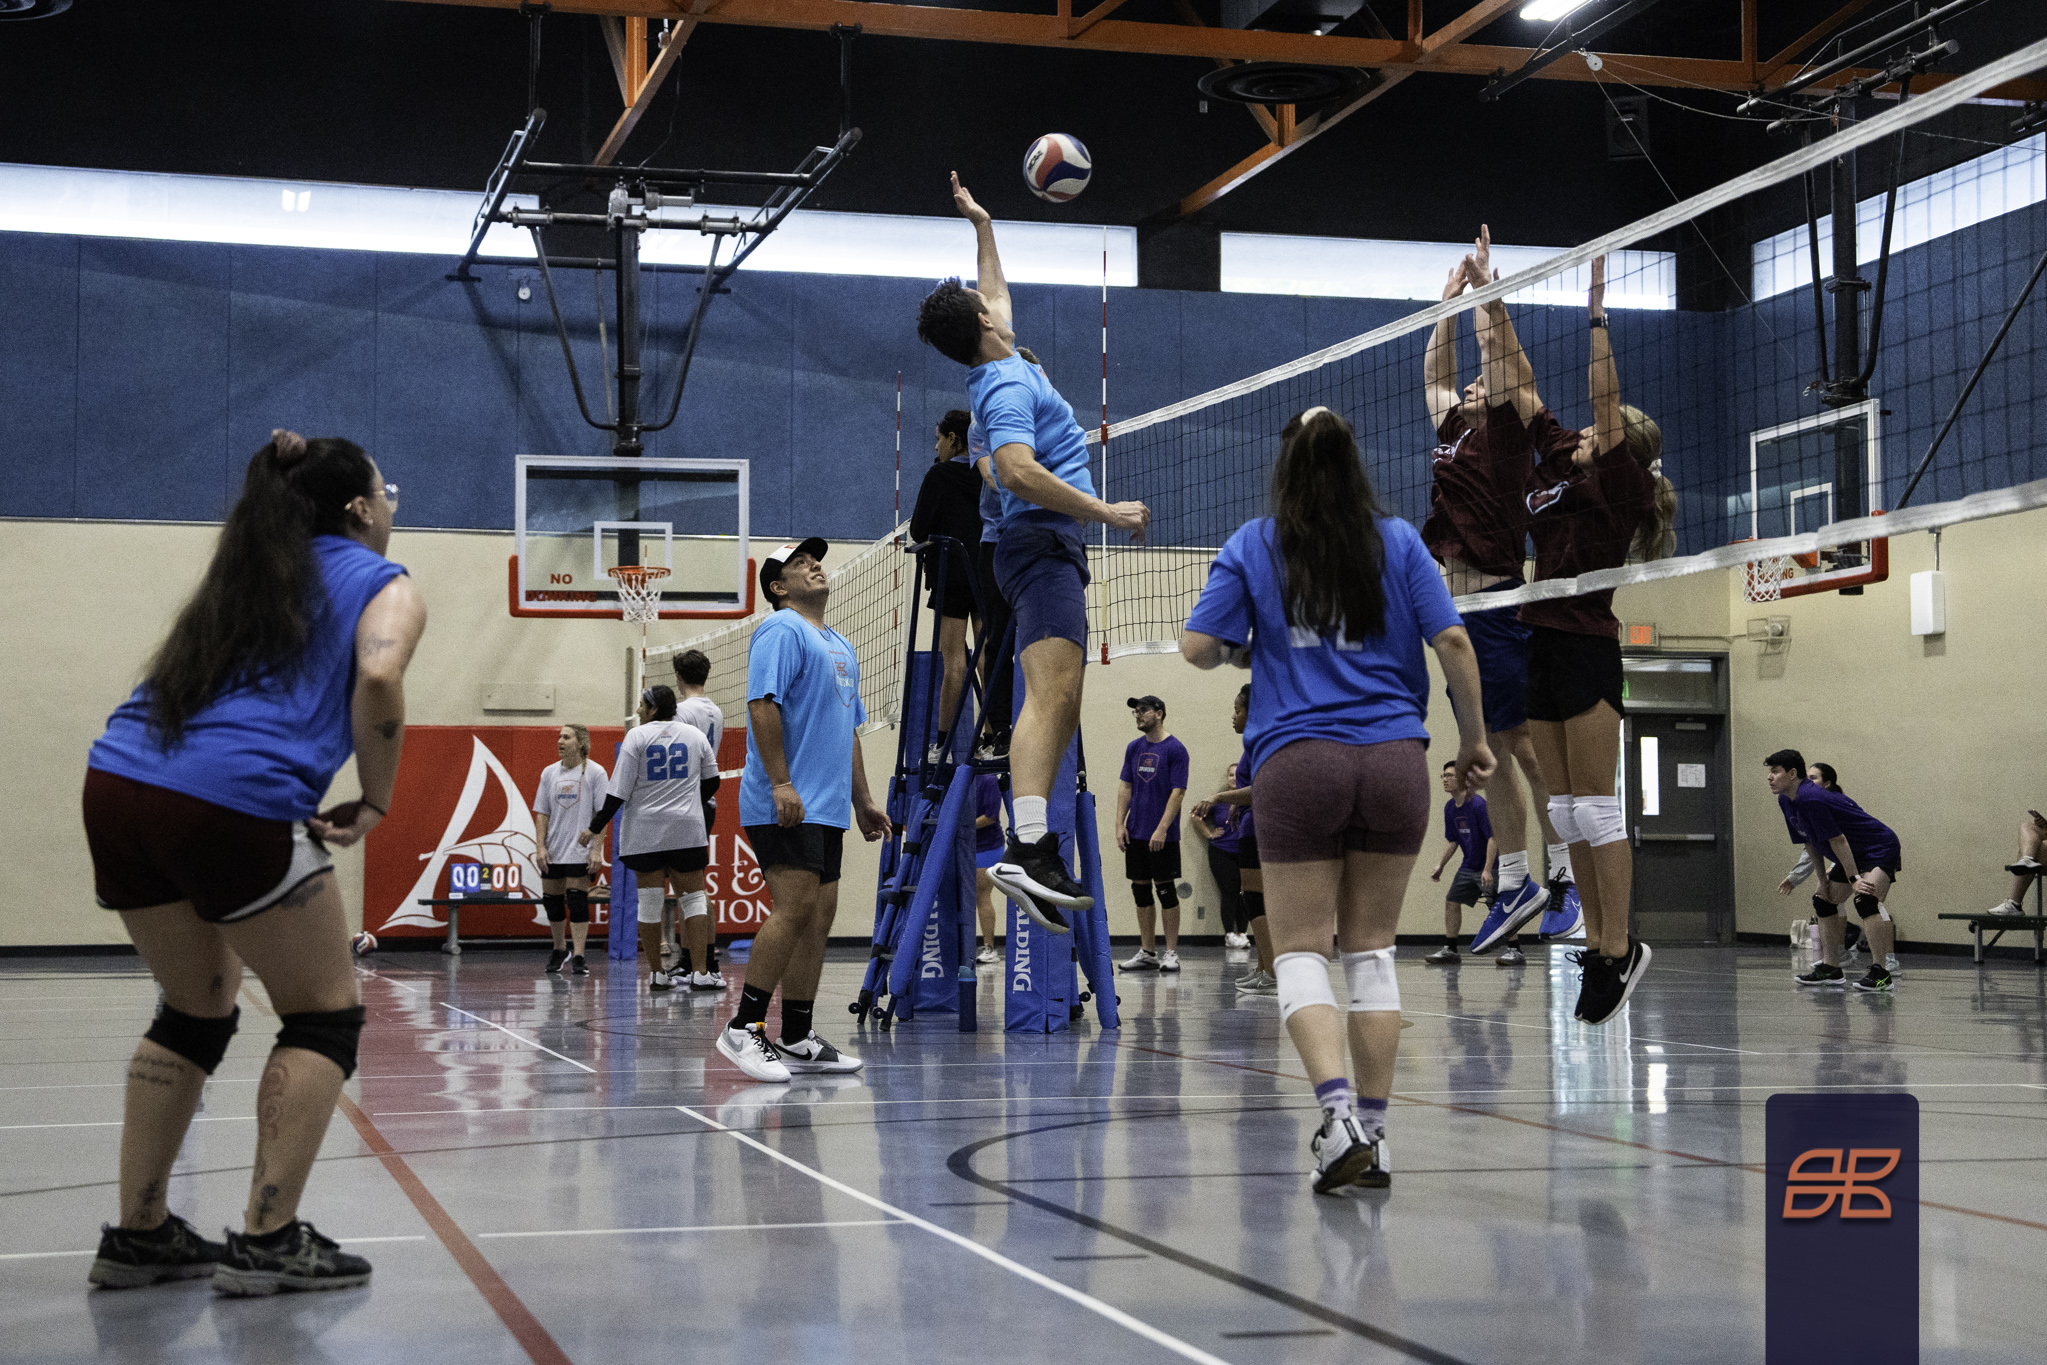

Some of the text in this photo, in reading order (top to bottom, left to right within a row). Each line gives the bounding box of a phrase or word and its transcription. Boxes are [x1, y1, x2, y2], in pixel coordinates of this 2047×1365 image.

[550, 573, 572, 584] NO
[525, 590, 597, 602] DUNKING
[1630, 625, 1651, 644] EXIT
[646, 743, 689, 781] 22
[482, 867, 490, 879] 2
